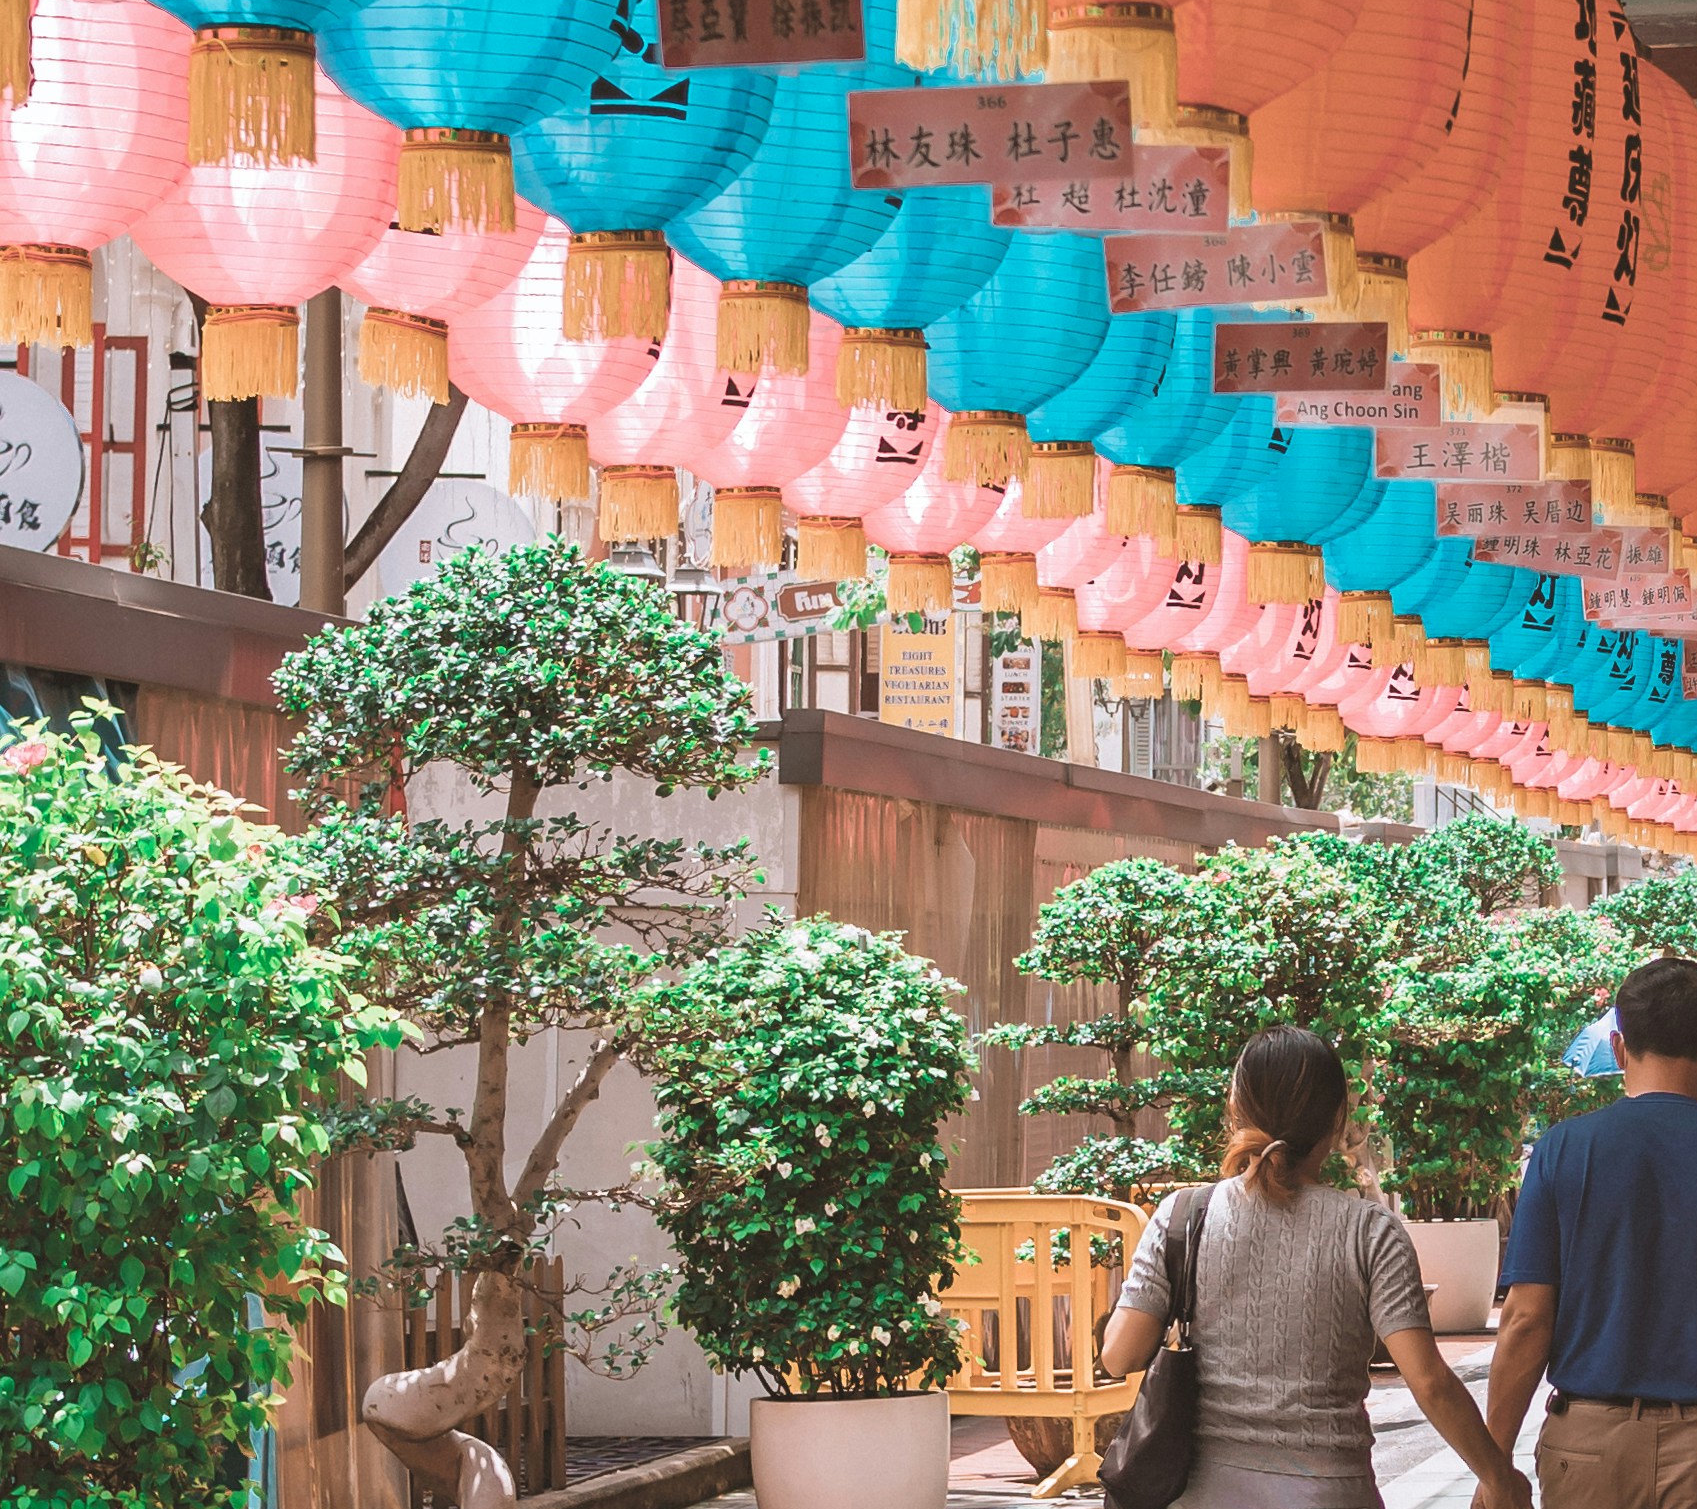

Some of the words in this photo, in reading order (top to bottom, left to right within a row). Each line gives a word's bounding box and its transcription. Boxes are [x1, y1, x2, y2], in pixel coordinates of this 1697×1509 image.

[975, 95, 1008, 110] 366
[864, 122, 984, 171] 林友珠
[1006, 116, 1122, 163] 杜子惠
[1226, 248, 1317, 288] 陳小雲
[1297, 401, 1329, 420] Ang
[1334, 400, 1389, 419] Choon
[1393, 402, 1420, 419] Sin
[1406, 441, 1511, 475] 王澤楷
[1444, 501, 1509, 526] 吴丽珠
[902, 651, 934, 661] EIGHT
[888, 665, 947, 676] TREASURES
[884, 680, 950, 691] VEGETARIAN
[884, 695, 951, 705] RESTAURANT
